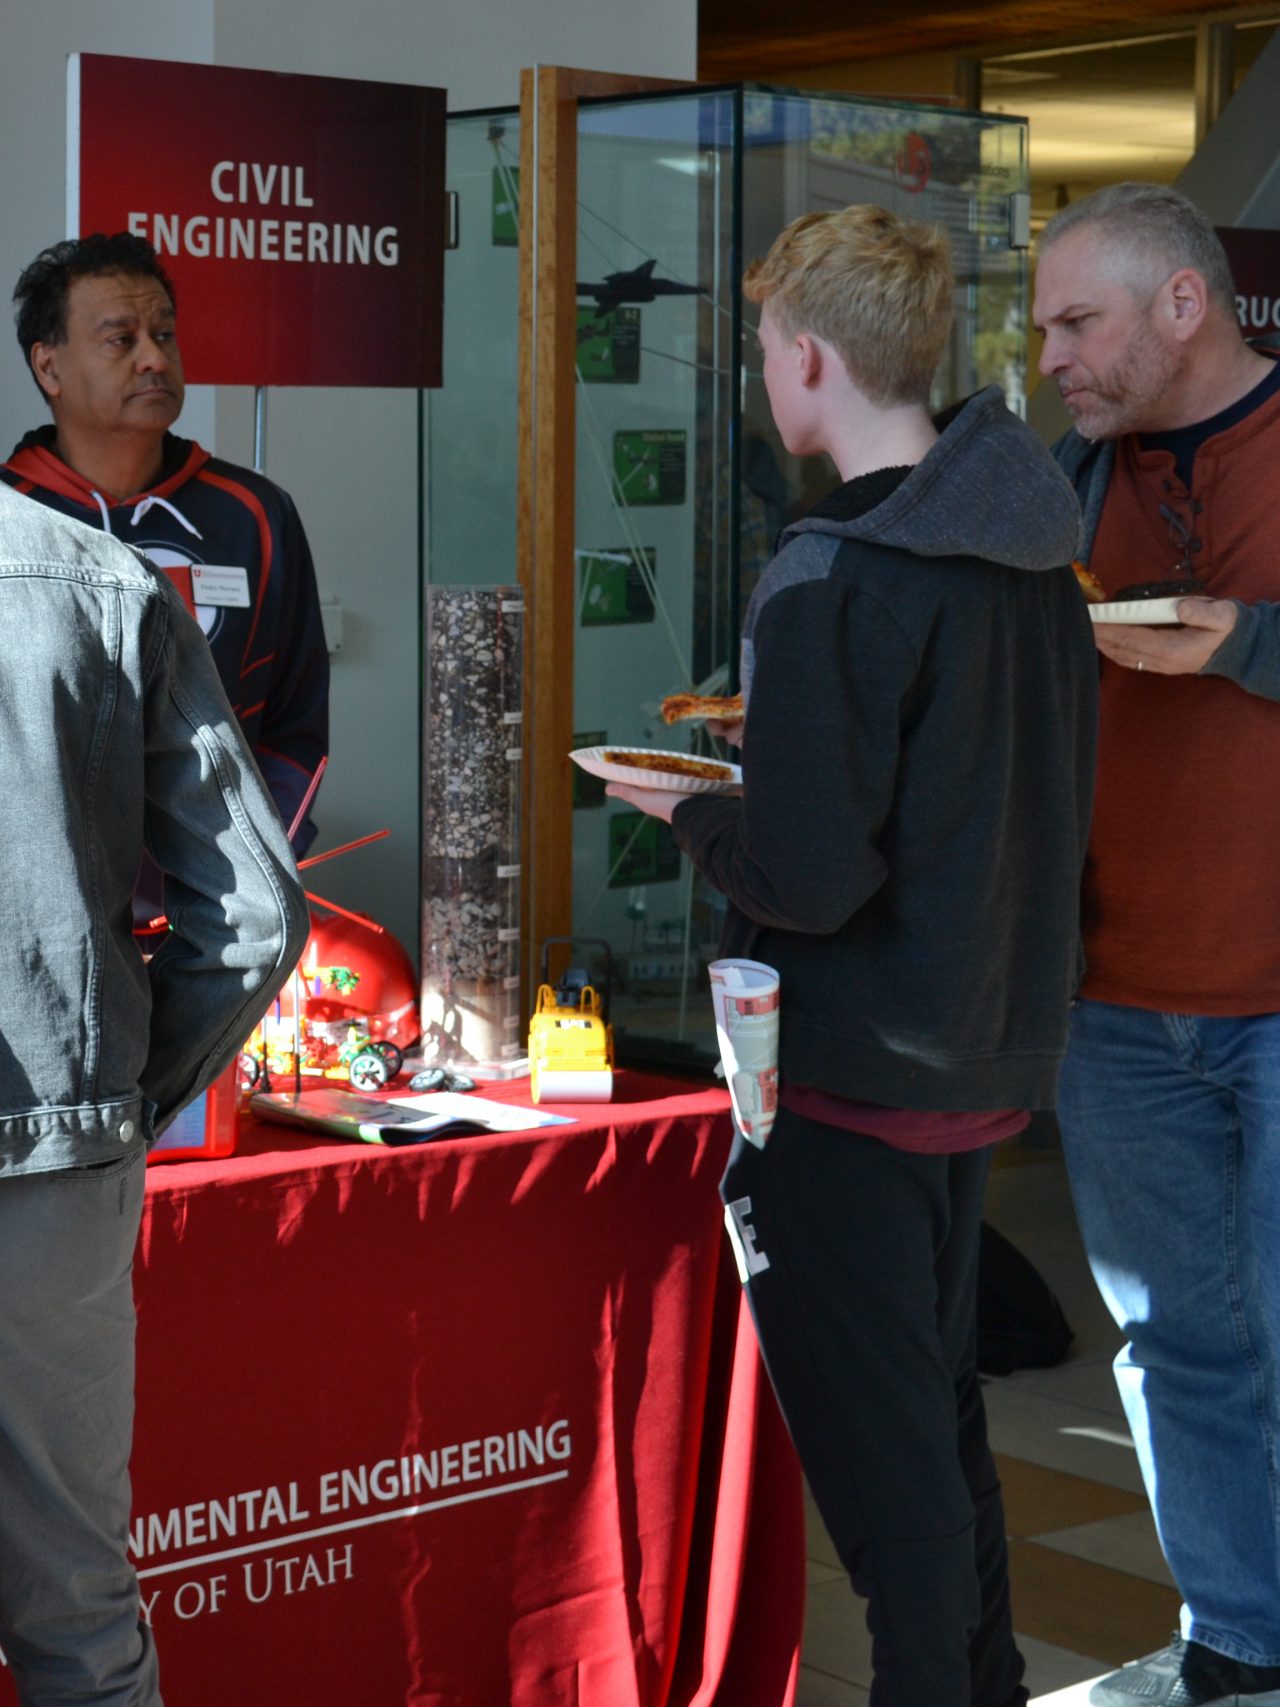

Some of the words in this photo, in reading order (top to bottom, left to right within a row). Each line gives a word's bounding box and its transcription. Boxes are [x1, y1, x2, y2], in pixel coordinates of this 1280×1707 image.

[210, 160, 314, 208] CIVIL
[127, 211, 399, 267] ENGINEERING
[319, 1419, 571, 1514] ENGINEERING
[174, 1575, 227, 1620] OF
[243, 1544, 354, 1603] UTAH
